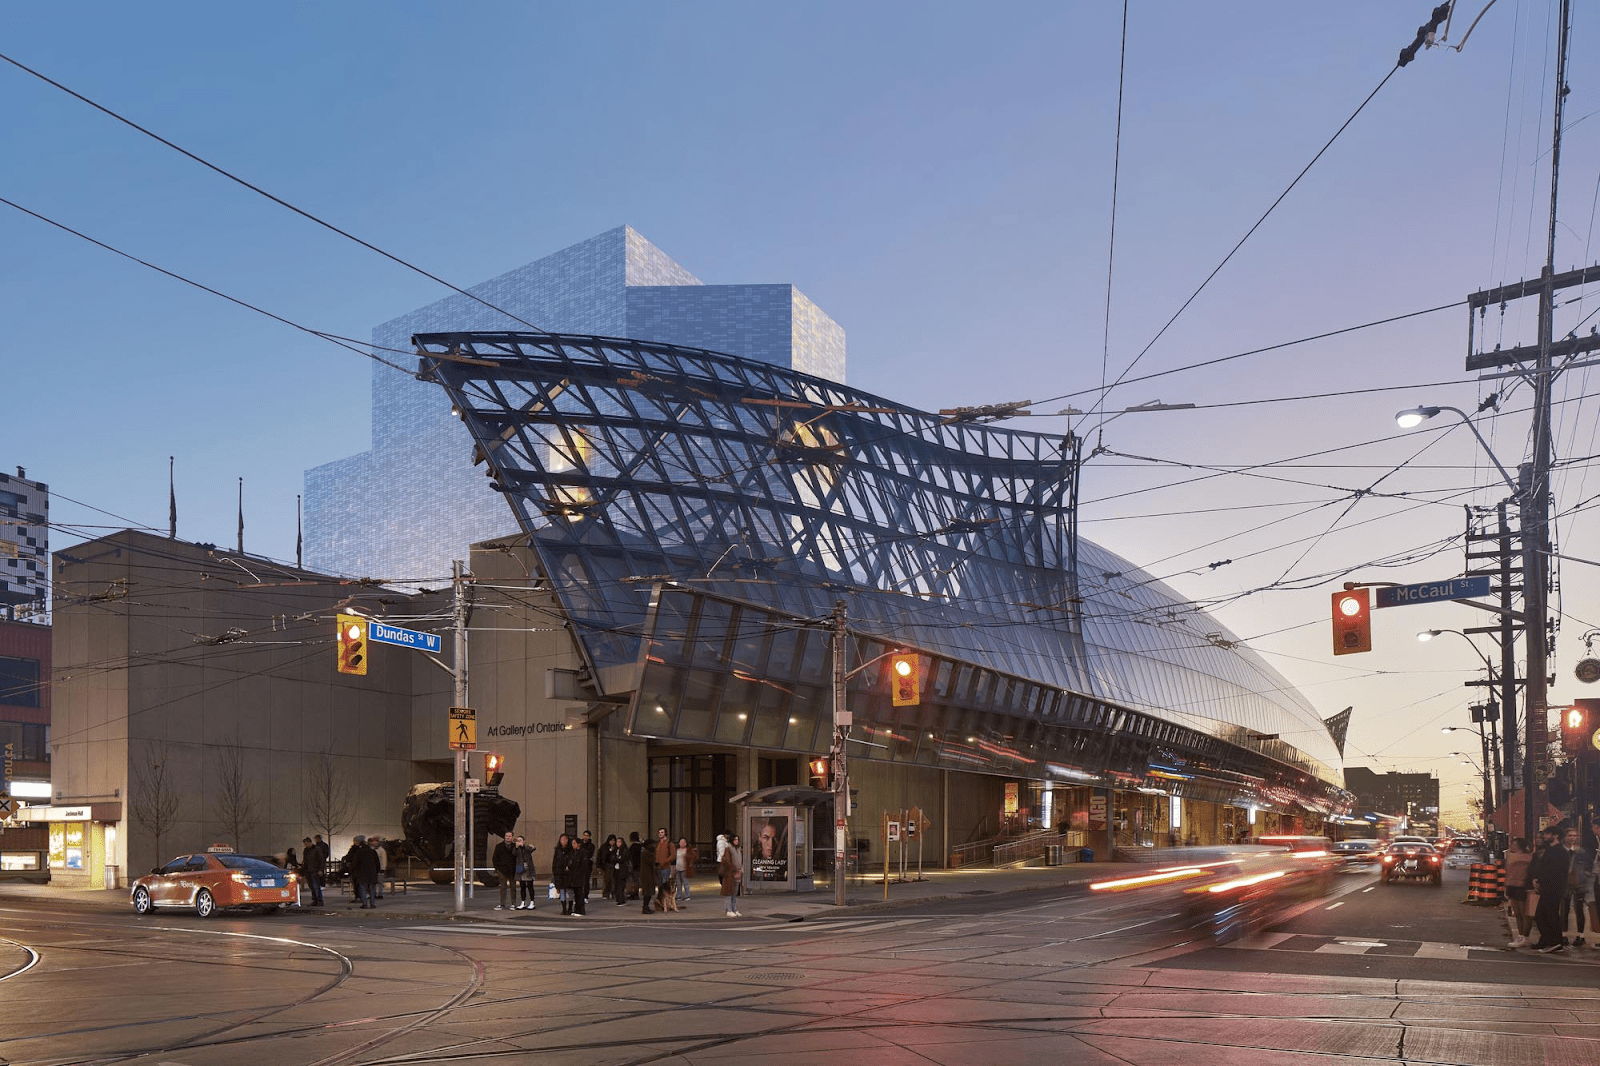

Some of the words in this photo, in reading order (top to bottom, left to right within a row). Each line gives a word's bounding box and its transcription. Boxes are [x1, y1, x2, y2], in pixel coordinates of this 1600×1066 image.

[1396, 582, 1455, 601] McCaul
[1460, 580, 1469, 588] St
[376, 625, 415, 644] Dundas
[417, 633, 424, 641] St
[426, 635, 436, 648] W
[487, 726, 498, 736] Art
[499, 725, 527, 737] Gallery
[527, 723, 535, 734] of
[536, 721, 566, 734] Ontario
[1090, 796, 1107, 821] AGO
